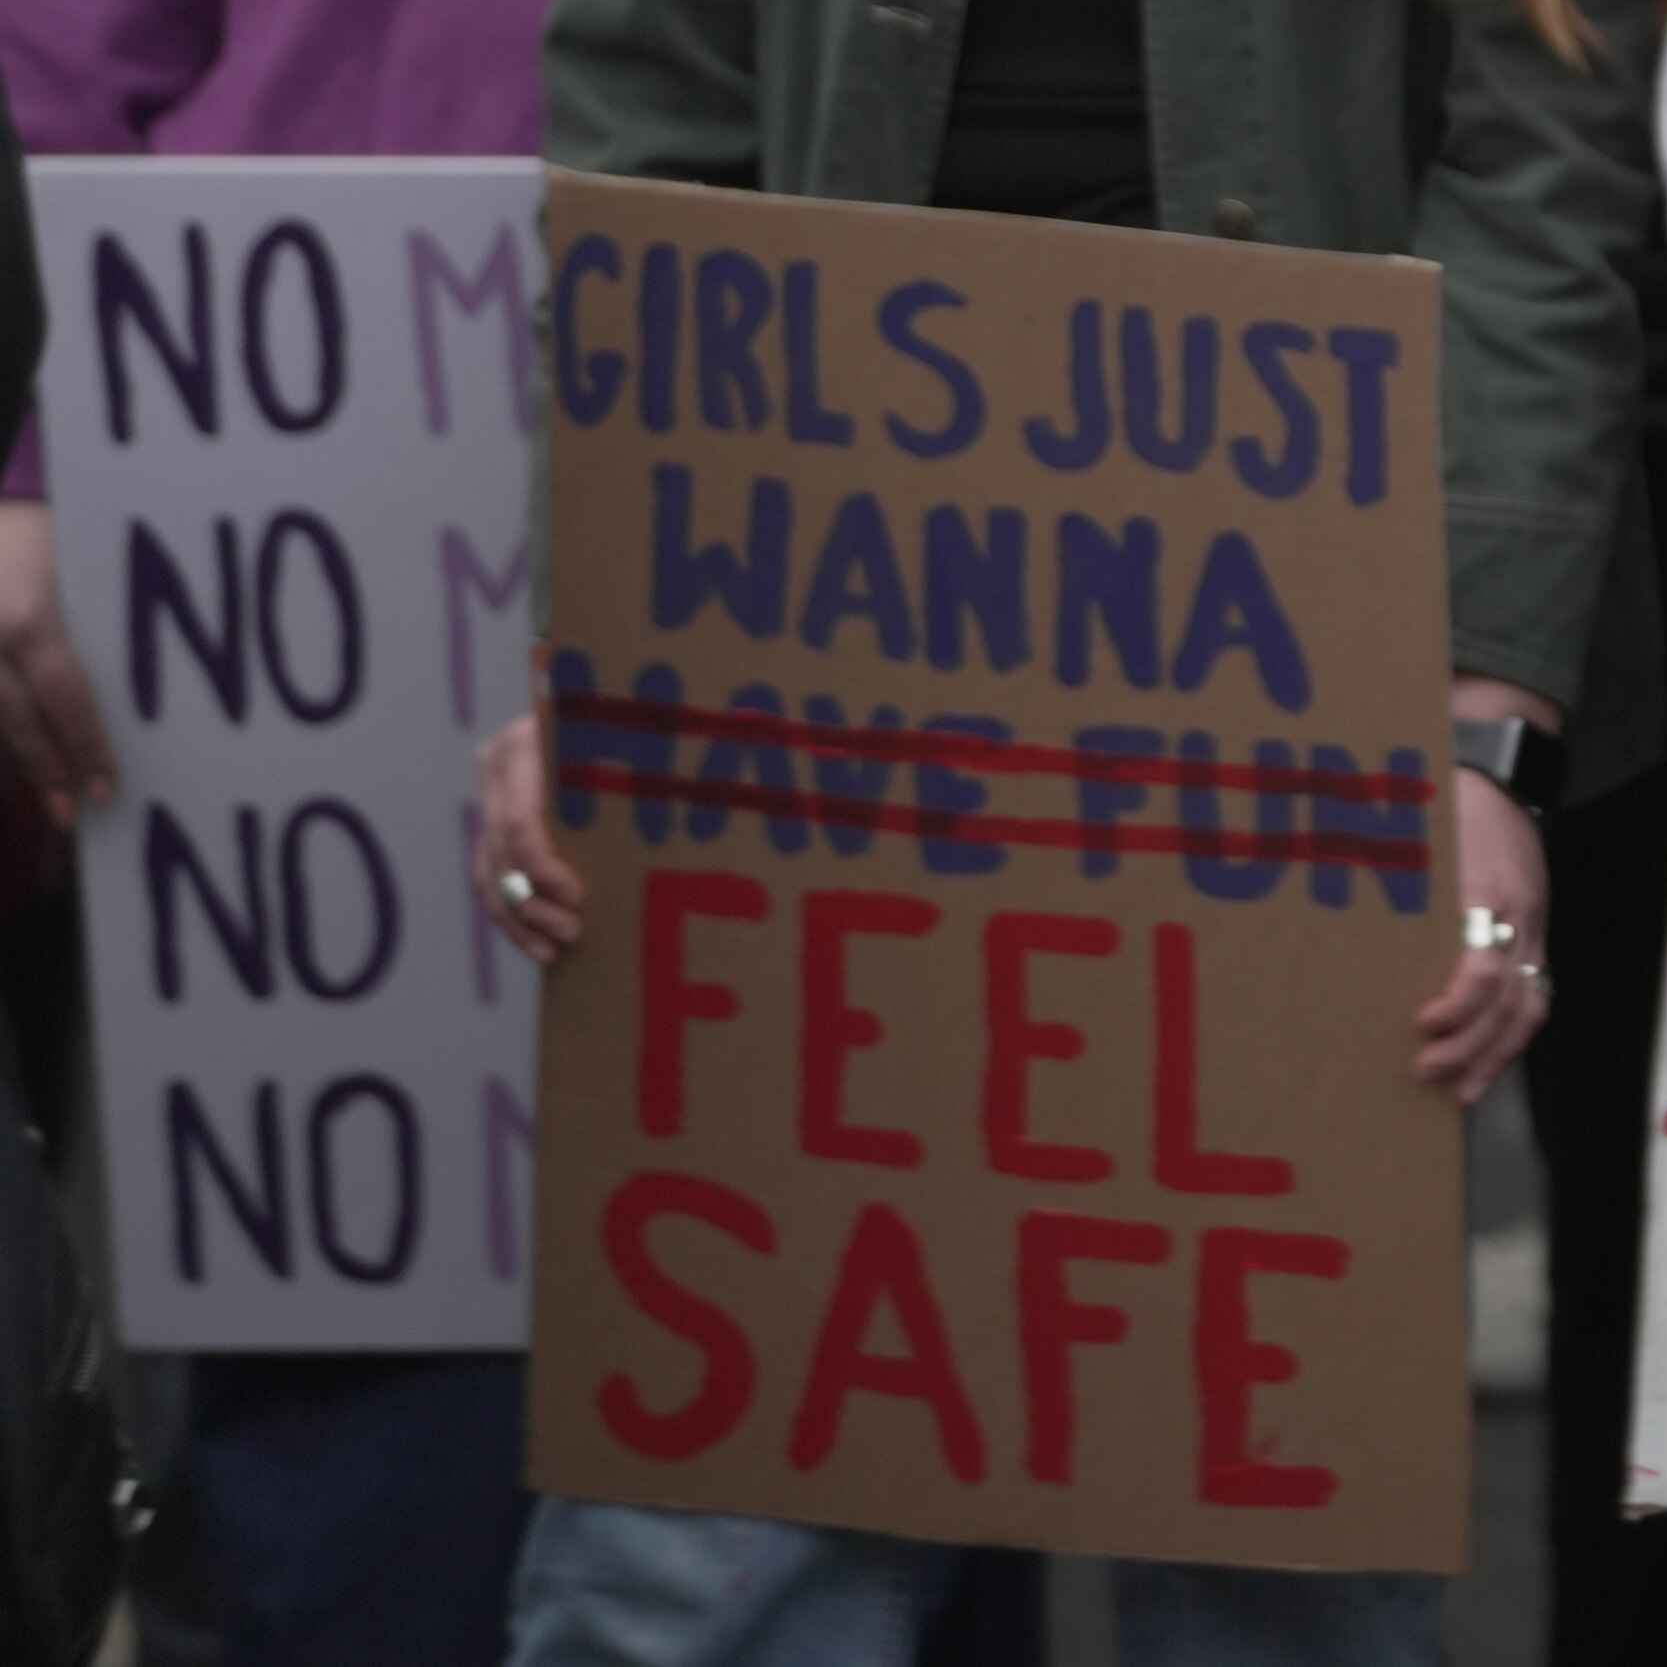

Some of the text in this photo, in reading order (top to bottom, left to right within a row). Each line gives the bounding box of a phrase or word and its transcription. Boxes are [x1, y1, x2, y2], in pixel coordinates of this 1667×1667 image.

[92, 220, 348, 444] NO
[554, 233, 1398, 507] GIRLS JUST
[128, 507, 366, 728] NO
[650, 461, 1313, 714] WANNA
[142, 793, 404, 1008] NO
[549, 647, 1430, 915] HAVE FUN
[637, 867, 1297, 1198] FEEL
[166, 1072, 424, 1289] NO
[596, 1170, 1353, 1509] SAFE
